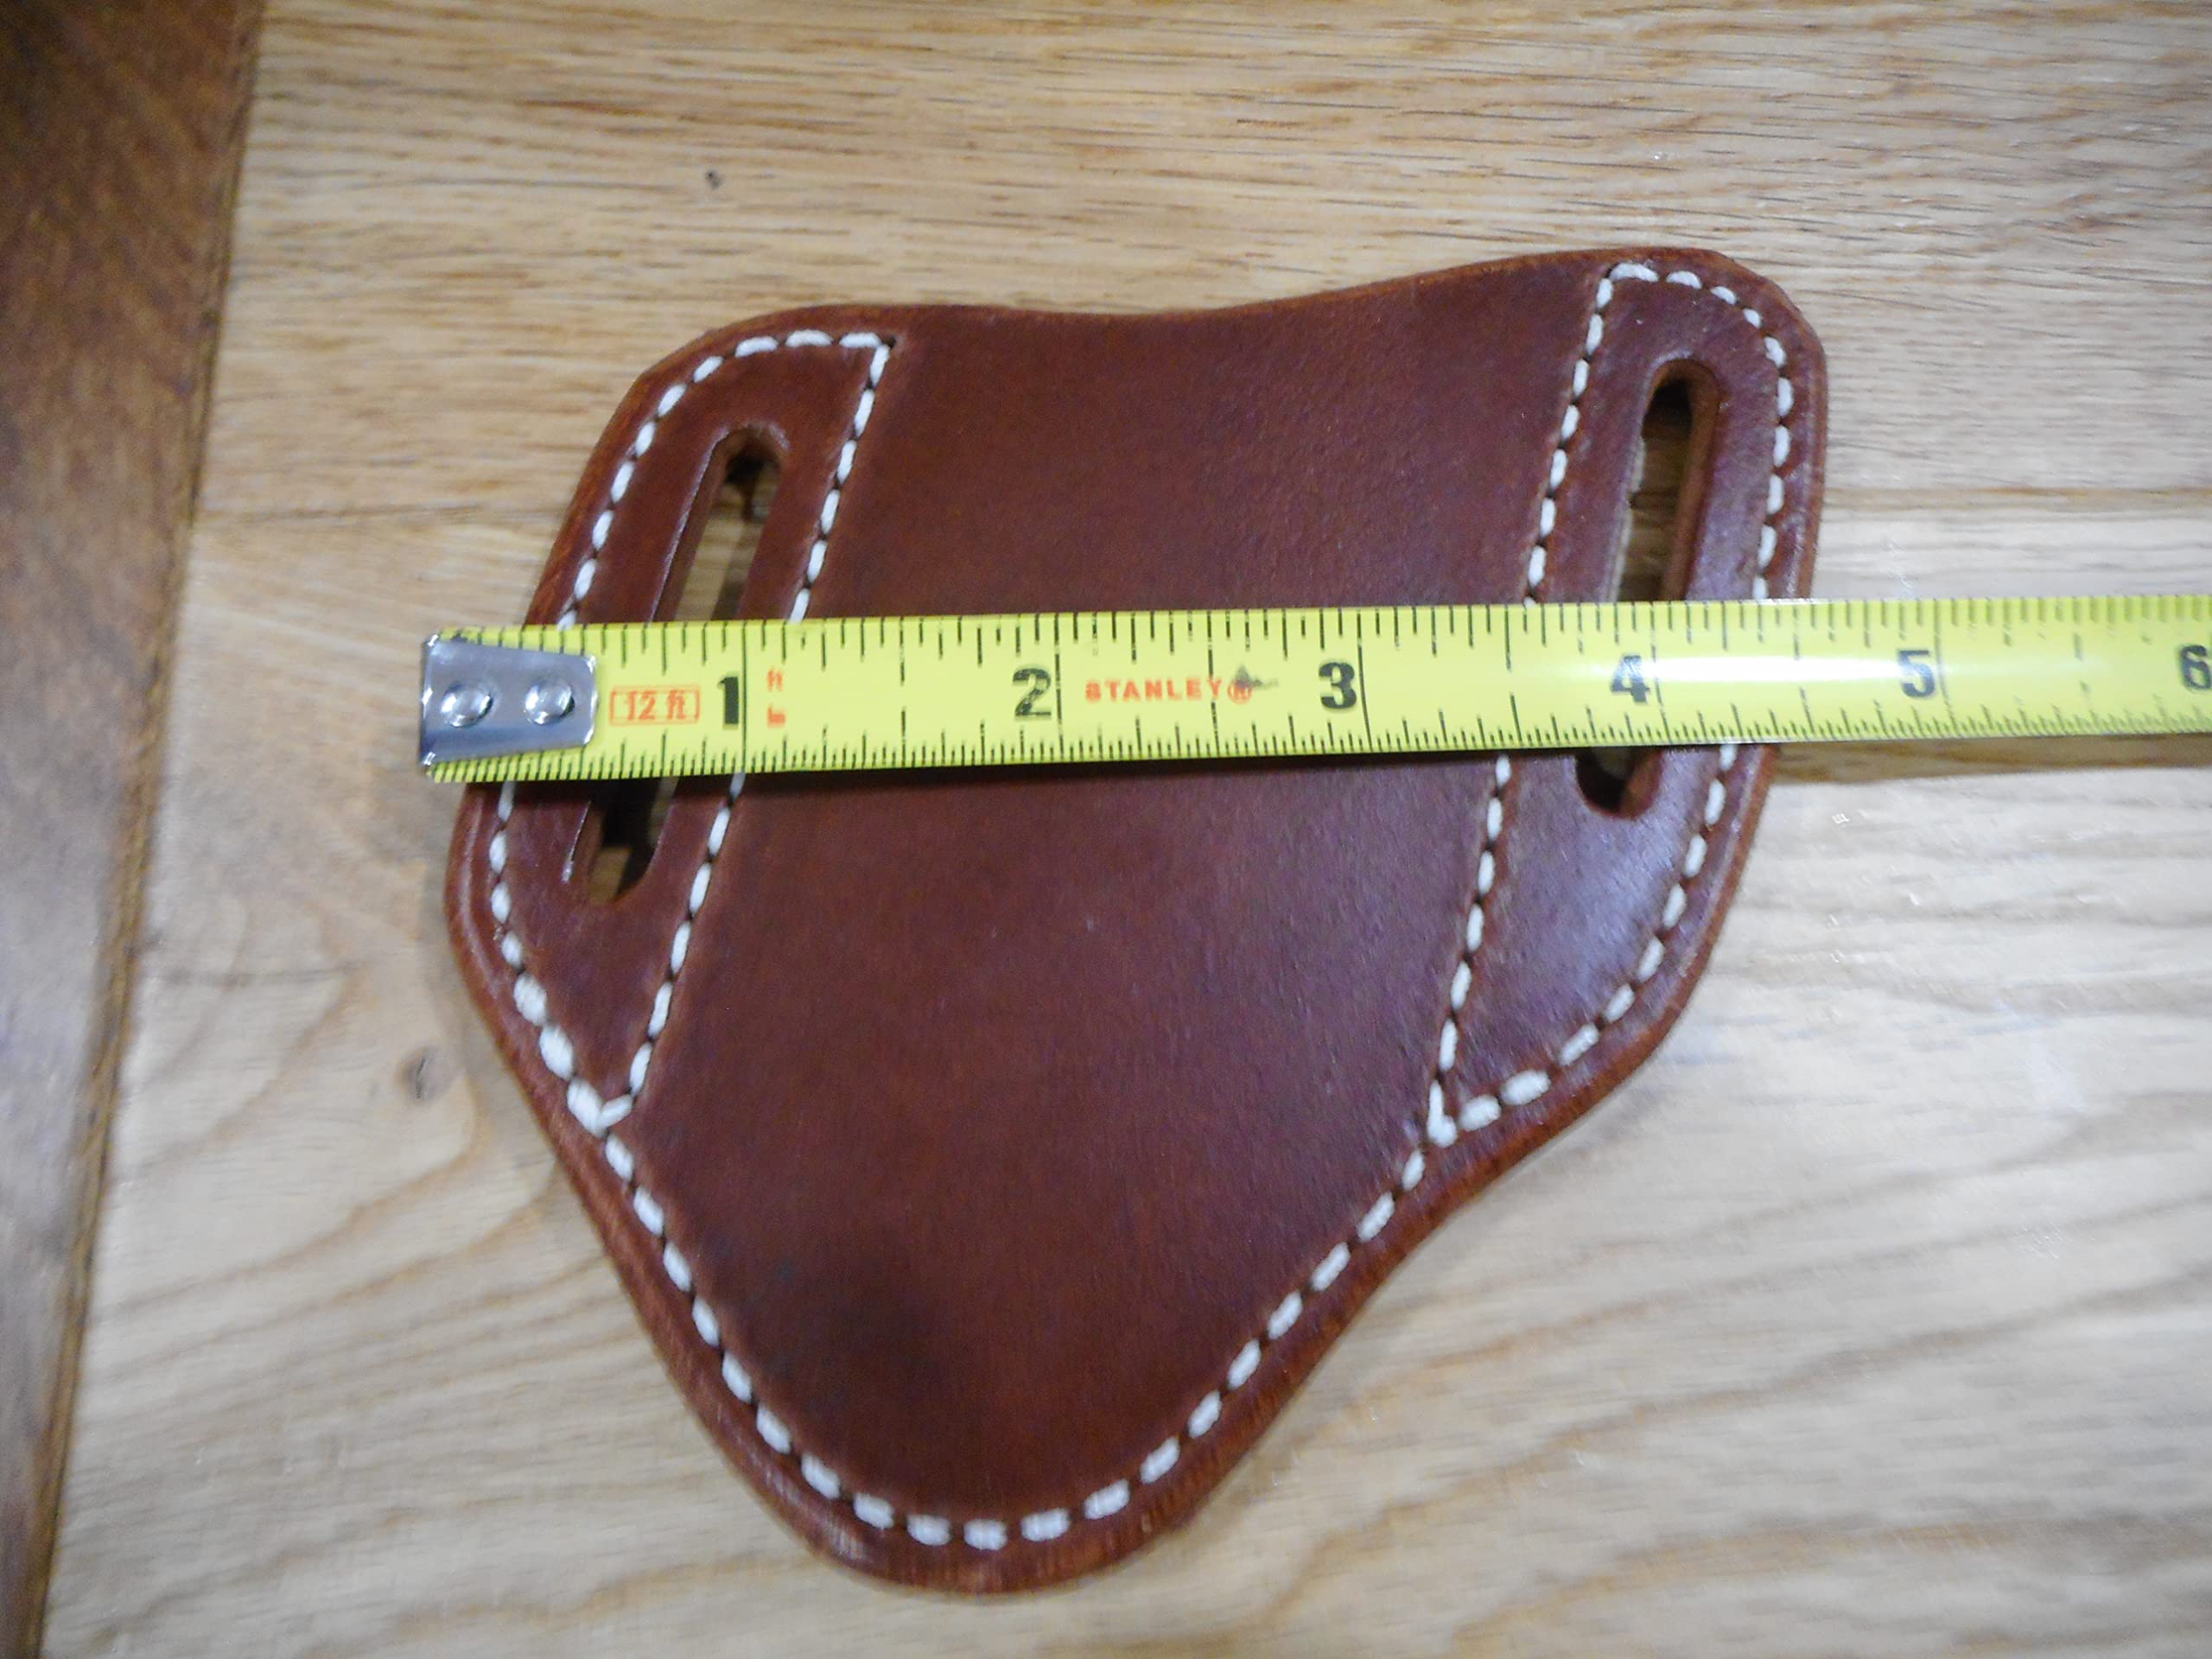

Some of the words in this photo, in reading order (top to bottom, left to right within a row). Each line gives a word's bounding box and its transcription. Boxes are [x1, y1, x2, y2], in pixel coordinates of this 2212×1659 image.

[1319, 662, 1357, 709] 3
[1611, 655, 1649, 702] 4
[1898, 650, 1936, 698] 5
[2178, 644, 2211, 692] 6
[626, 690, 657, 721] 12
[667, 690, 687, 721] ft
[718, 674, 740, 728] 1
[1013, 668, 1052, 718] 2
